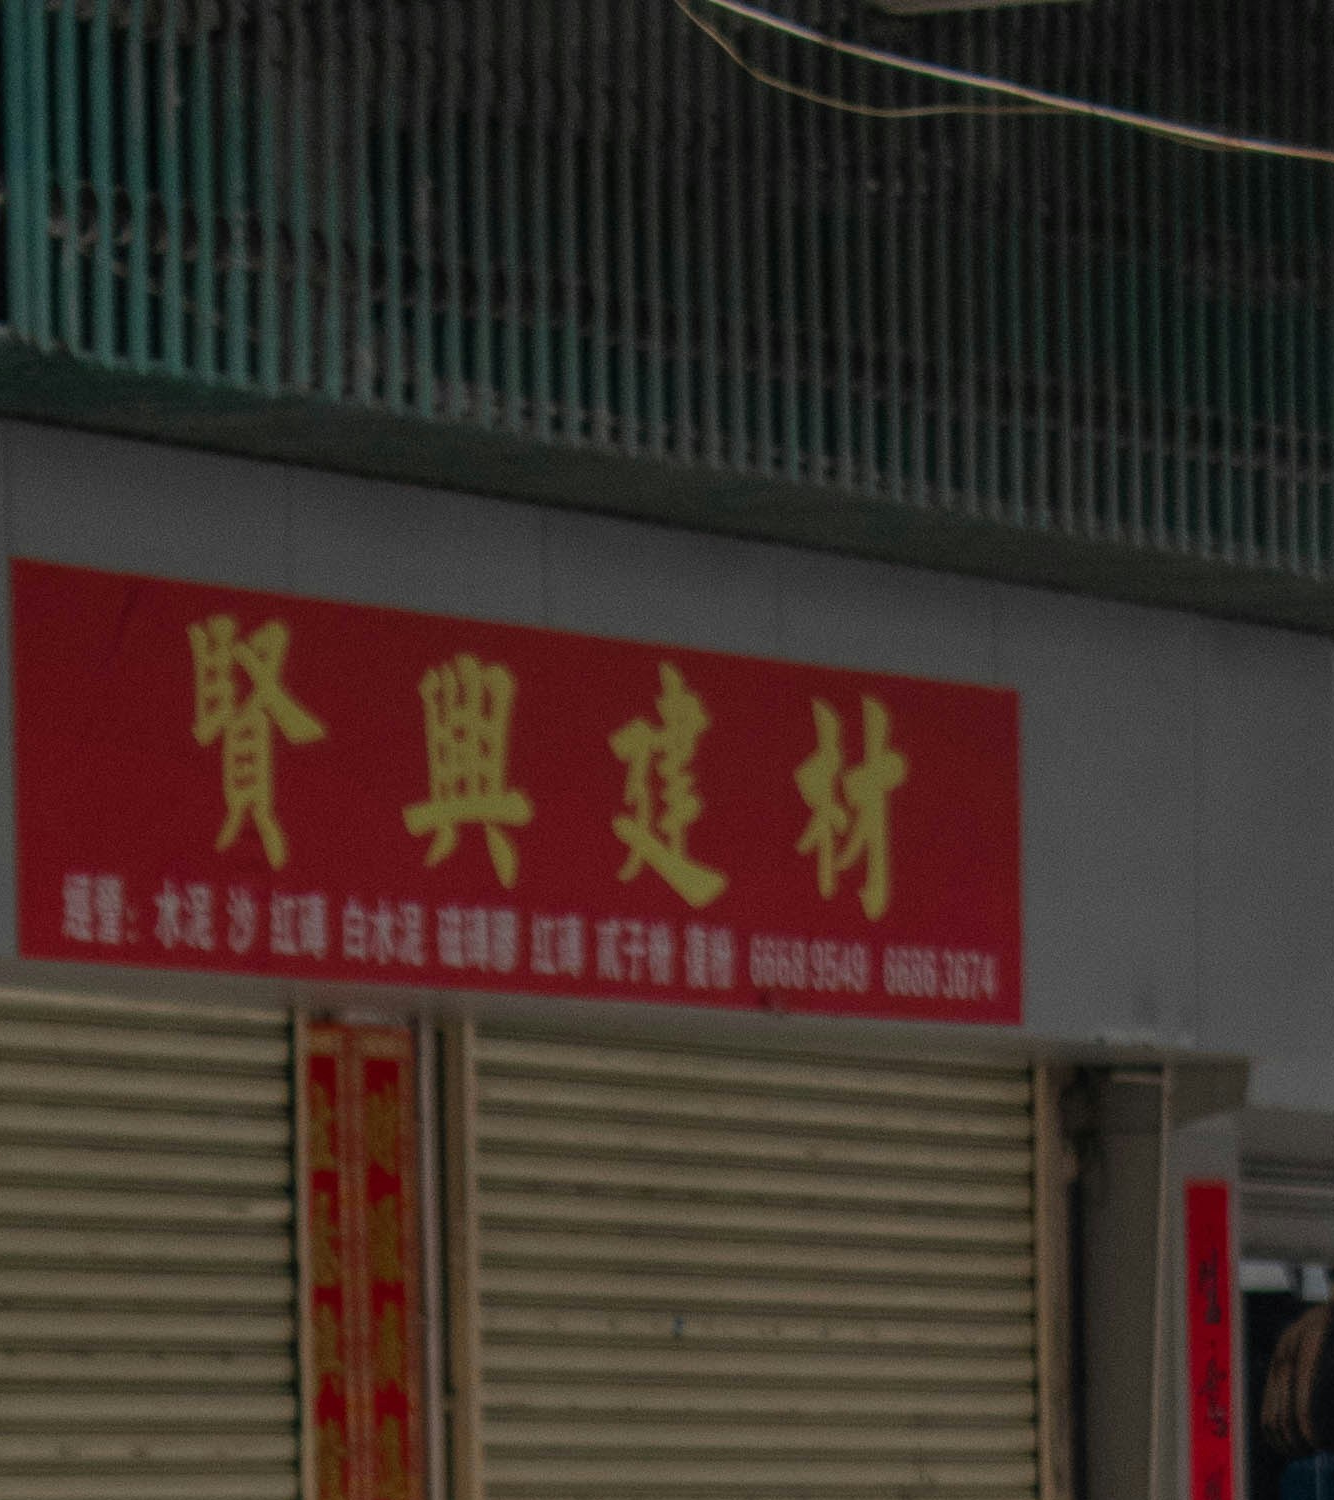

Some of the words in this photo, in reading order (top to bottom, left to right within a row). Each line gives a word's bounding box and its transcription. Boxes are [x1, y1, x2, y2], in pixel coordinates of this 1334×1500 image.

[185, 612, 911, 924] 賢興建材
[154, 878, 214, 951] 水泥
[225, 883, 257, 954] 沙
[340, 892, 424, 967] 白水泥
